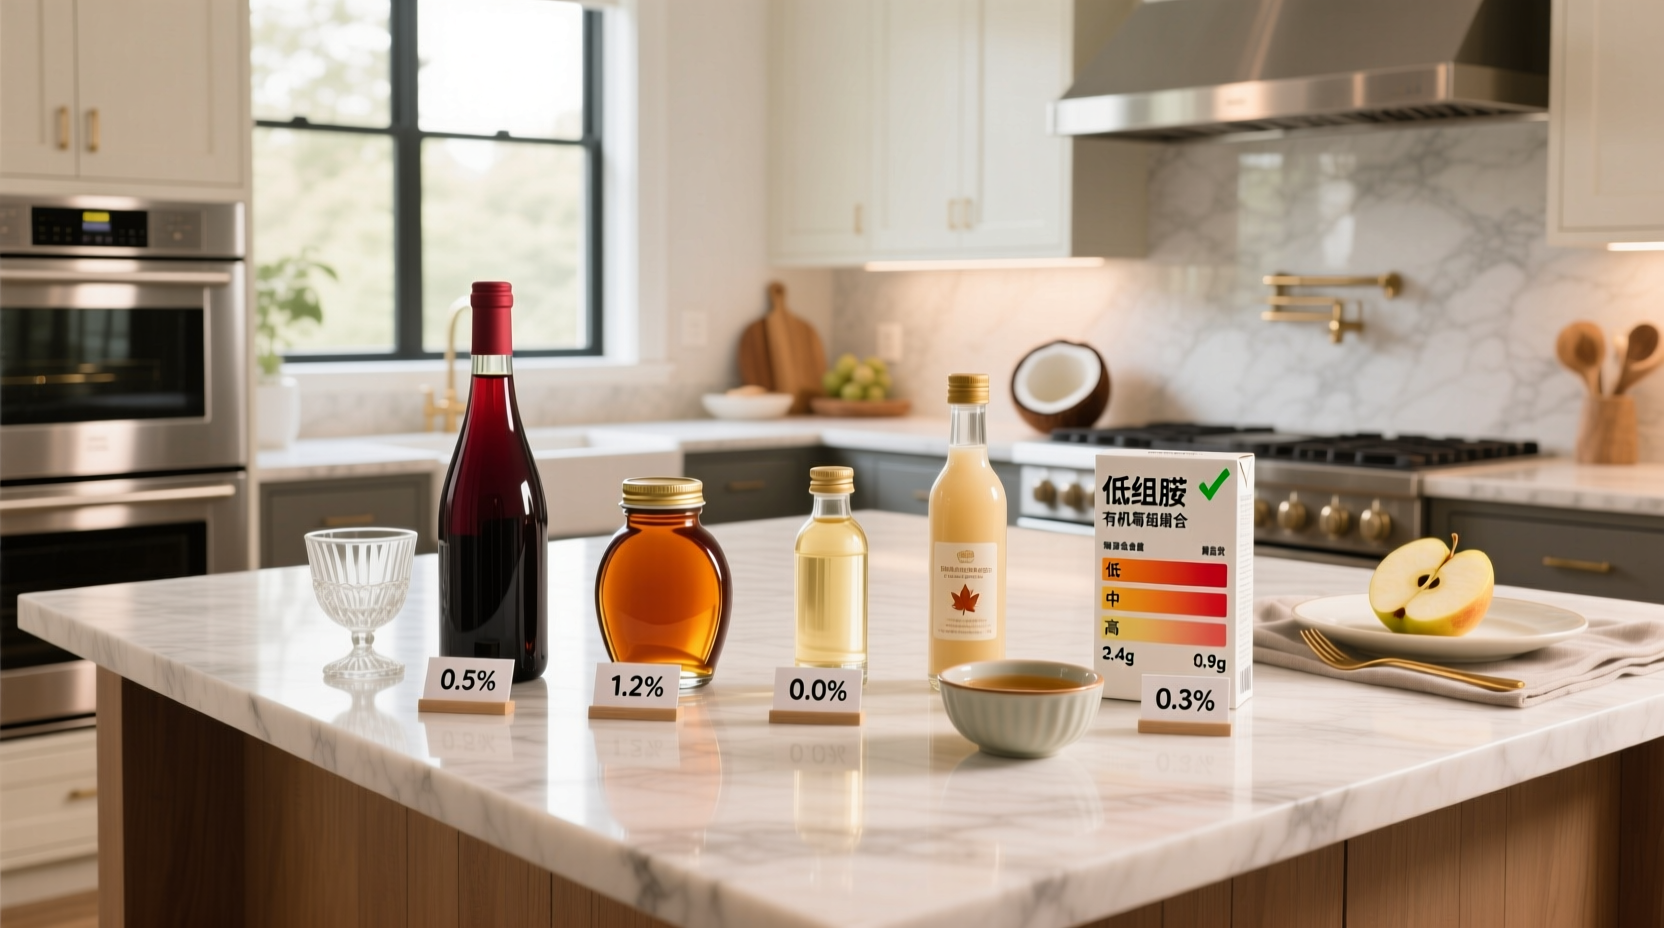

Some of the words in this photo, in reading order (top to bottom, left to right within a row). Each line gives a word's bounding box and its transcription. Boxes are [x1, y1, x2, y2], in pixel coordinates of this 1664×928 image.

[1105, 561, 1121, 578] 低
[1106, 590, 1120, 607] 中
[1104, 619, 1119, 636] 高
[1102, 645, 1135, 666] 2.4g
[1193, 653, 1226, 674] 0.9g
[440, 668, 496, 692] 0.5%
[611, 674, 664, 698] 1.2%
[789, 678, 847, 702] 0.0%
[1155, 687, 1215, 711] 0.3%
